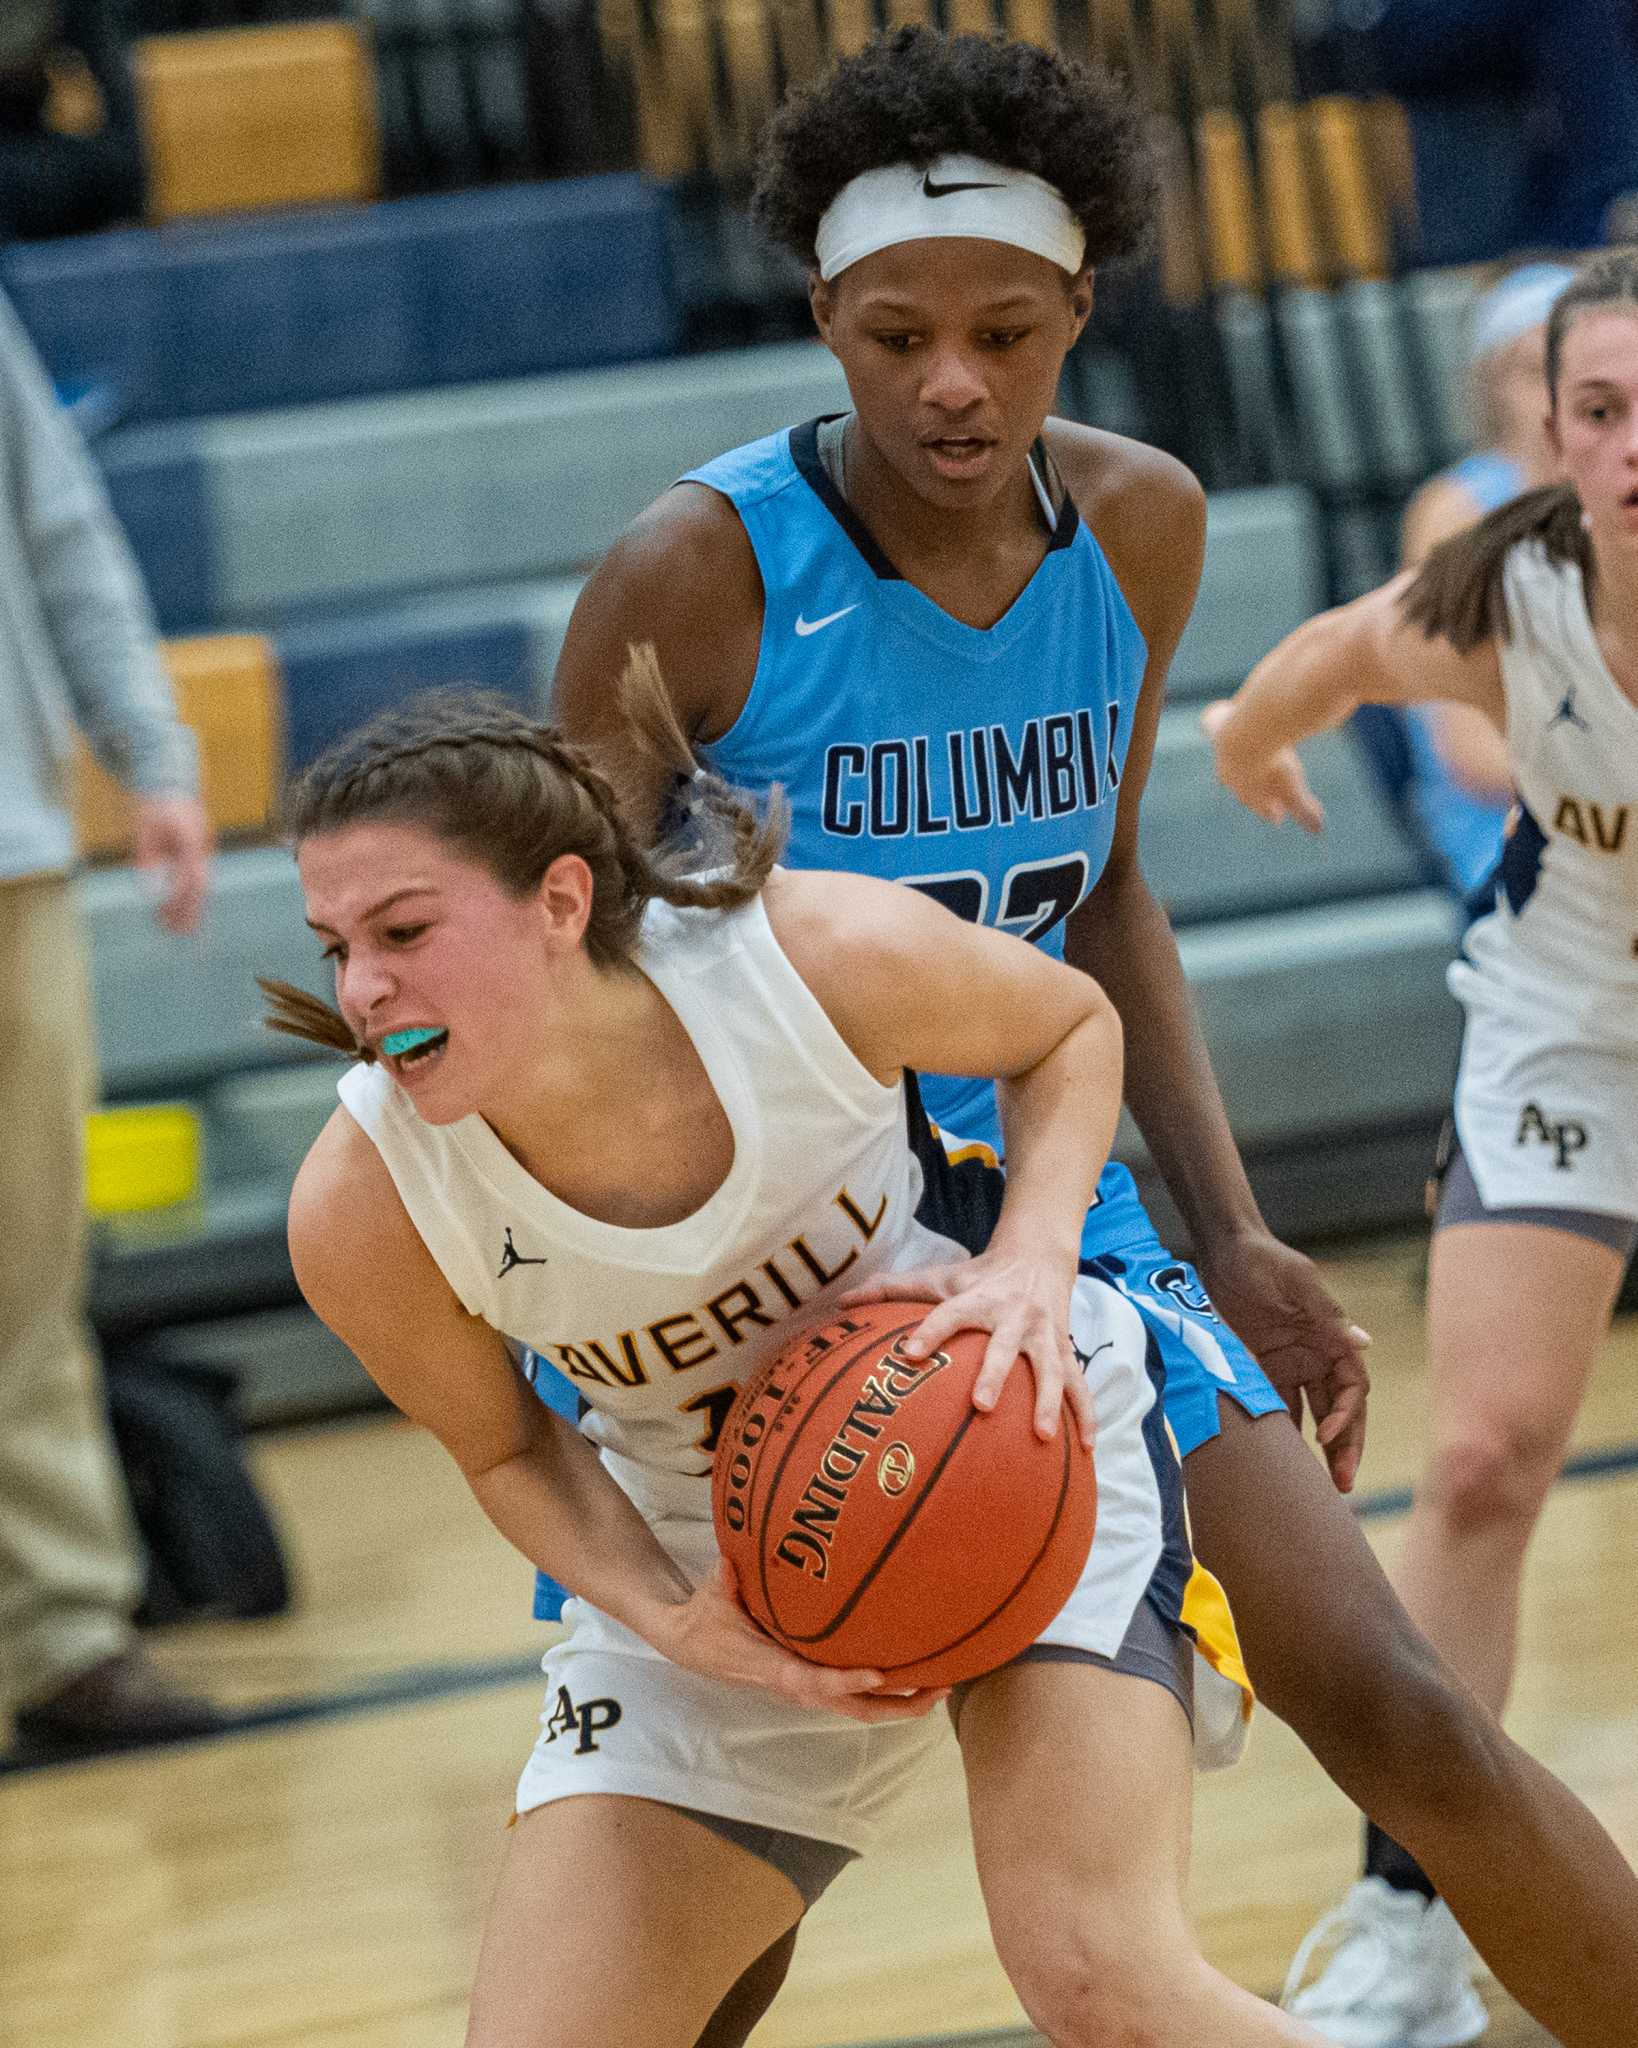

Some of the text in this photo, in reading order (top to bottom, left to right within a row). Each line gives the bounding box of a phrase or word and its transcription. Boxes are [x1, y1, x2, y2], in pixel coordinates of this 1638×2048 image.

[894, 851, 1088, 943] 2
[553, 1184, 888, 1389] AVERILL
[544, 1684, 622, 1755] AP
